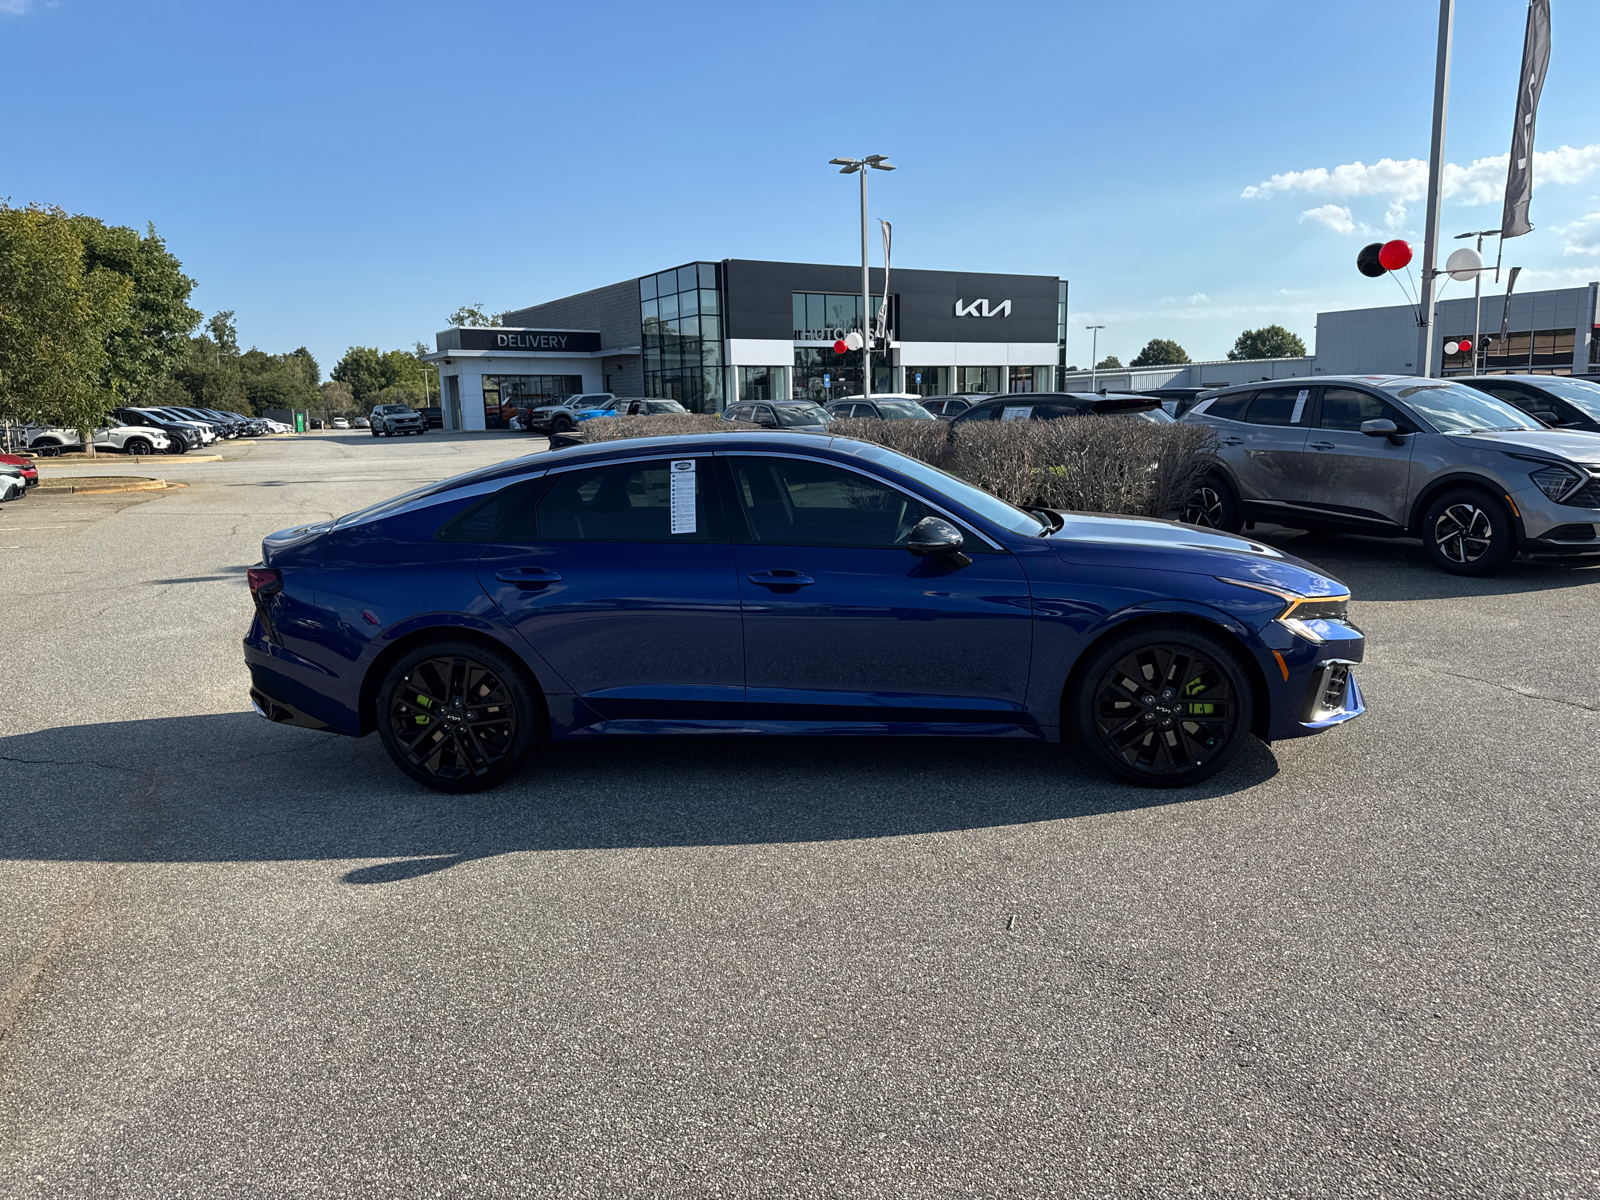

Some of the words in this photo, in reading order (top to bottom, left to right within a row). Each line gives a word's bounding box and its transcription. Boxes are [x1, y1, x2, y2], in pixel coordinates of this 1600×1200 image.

[955, 298, 1011, 317] KIA
[497, 334, 568, 348] DELIVERY
[803, 328, 893, 341] HUTCHSN
